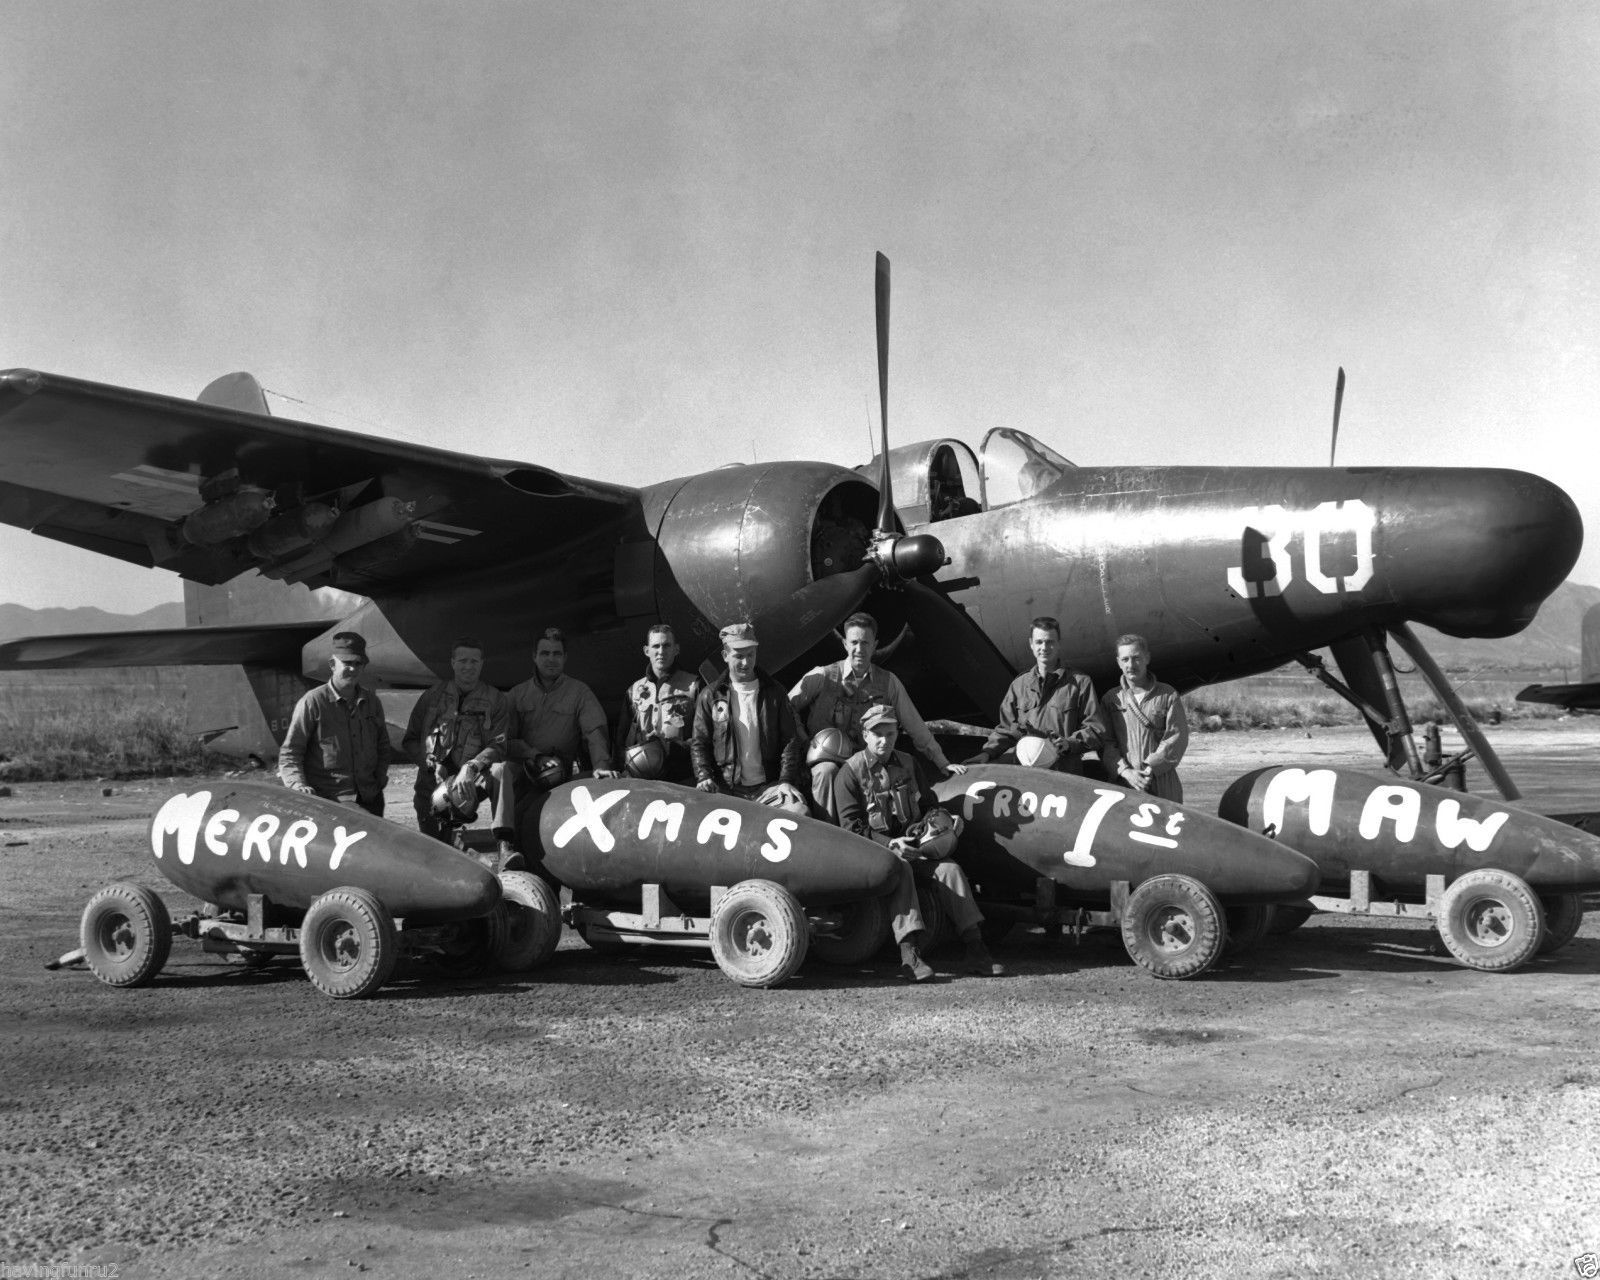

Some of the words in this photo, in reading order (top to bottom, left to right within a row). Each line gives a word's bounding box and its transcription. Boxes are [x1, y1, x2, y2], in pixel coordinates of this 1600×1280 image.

[1227, 499, 1375, 599] 30
[151, 791, 367, 871] MERRY
[553, 785, 798, 863] XMAS
[963, 781, 1068, 820] FROM
[1263, 768, 1509, 851] MAW
